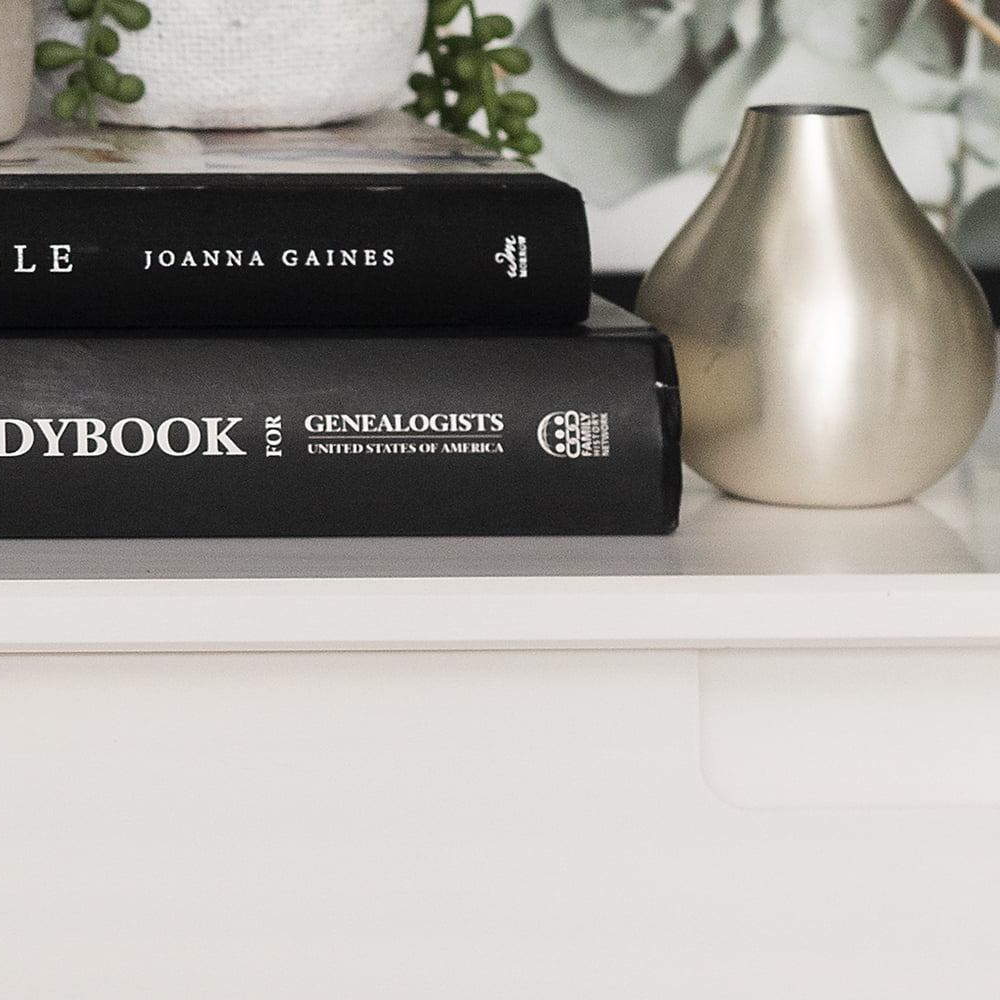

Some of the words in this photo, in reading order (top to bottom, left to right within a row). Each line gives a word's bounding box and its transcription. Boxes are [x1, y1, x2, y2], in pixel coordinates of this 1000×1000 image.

[144, 249, 265, 270] JOANNA
[281, 248, 395, 267] GAINES
[517, 235, 528, 278] MORROW
[264, 414, 283, 458] FOR
[304, 412, 505, 433] GENEALOGISTS
[580, 411, 592, 457] FAMILY
[591, 411, 601, 457] HISTORY
[600, 412, 610, 457] NETWORK
[307, 443, 363, 455] UNITED
[365, 442, 417, 454] STATES
[418, 442, 438, 454] OF
[440, 442, 504, 454] AMERICA
